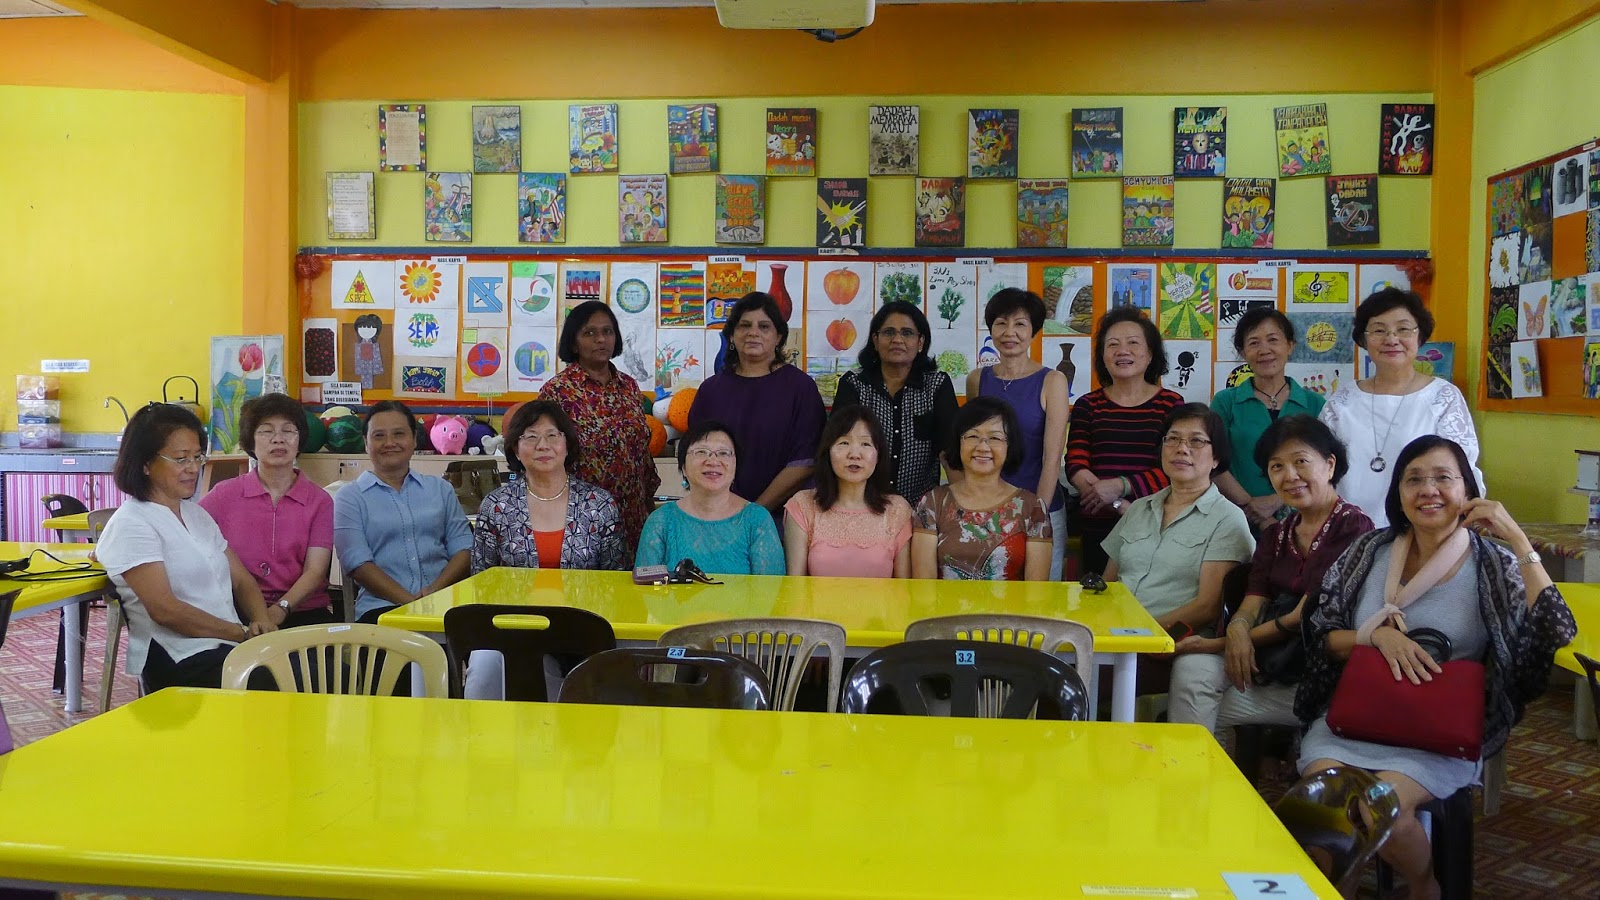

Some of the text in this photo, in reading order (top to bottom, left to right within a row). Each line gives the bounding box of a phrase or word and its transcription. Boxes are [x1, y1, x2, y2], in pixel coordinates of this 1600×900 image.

[878, 106, 912, 116] DADAH
[870, 114, 918, 124] MEMBAWA
[880, 123, 911, 133] MAUT
[1339, 189, 1367, 198] DADAH
[958, 652, 973, 663] 3.2
[1252, 879, 1287, 894] 2
